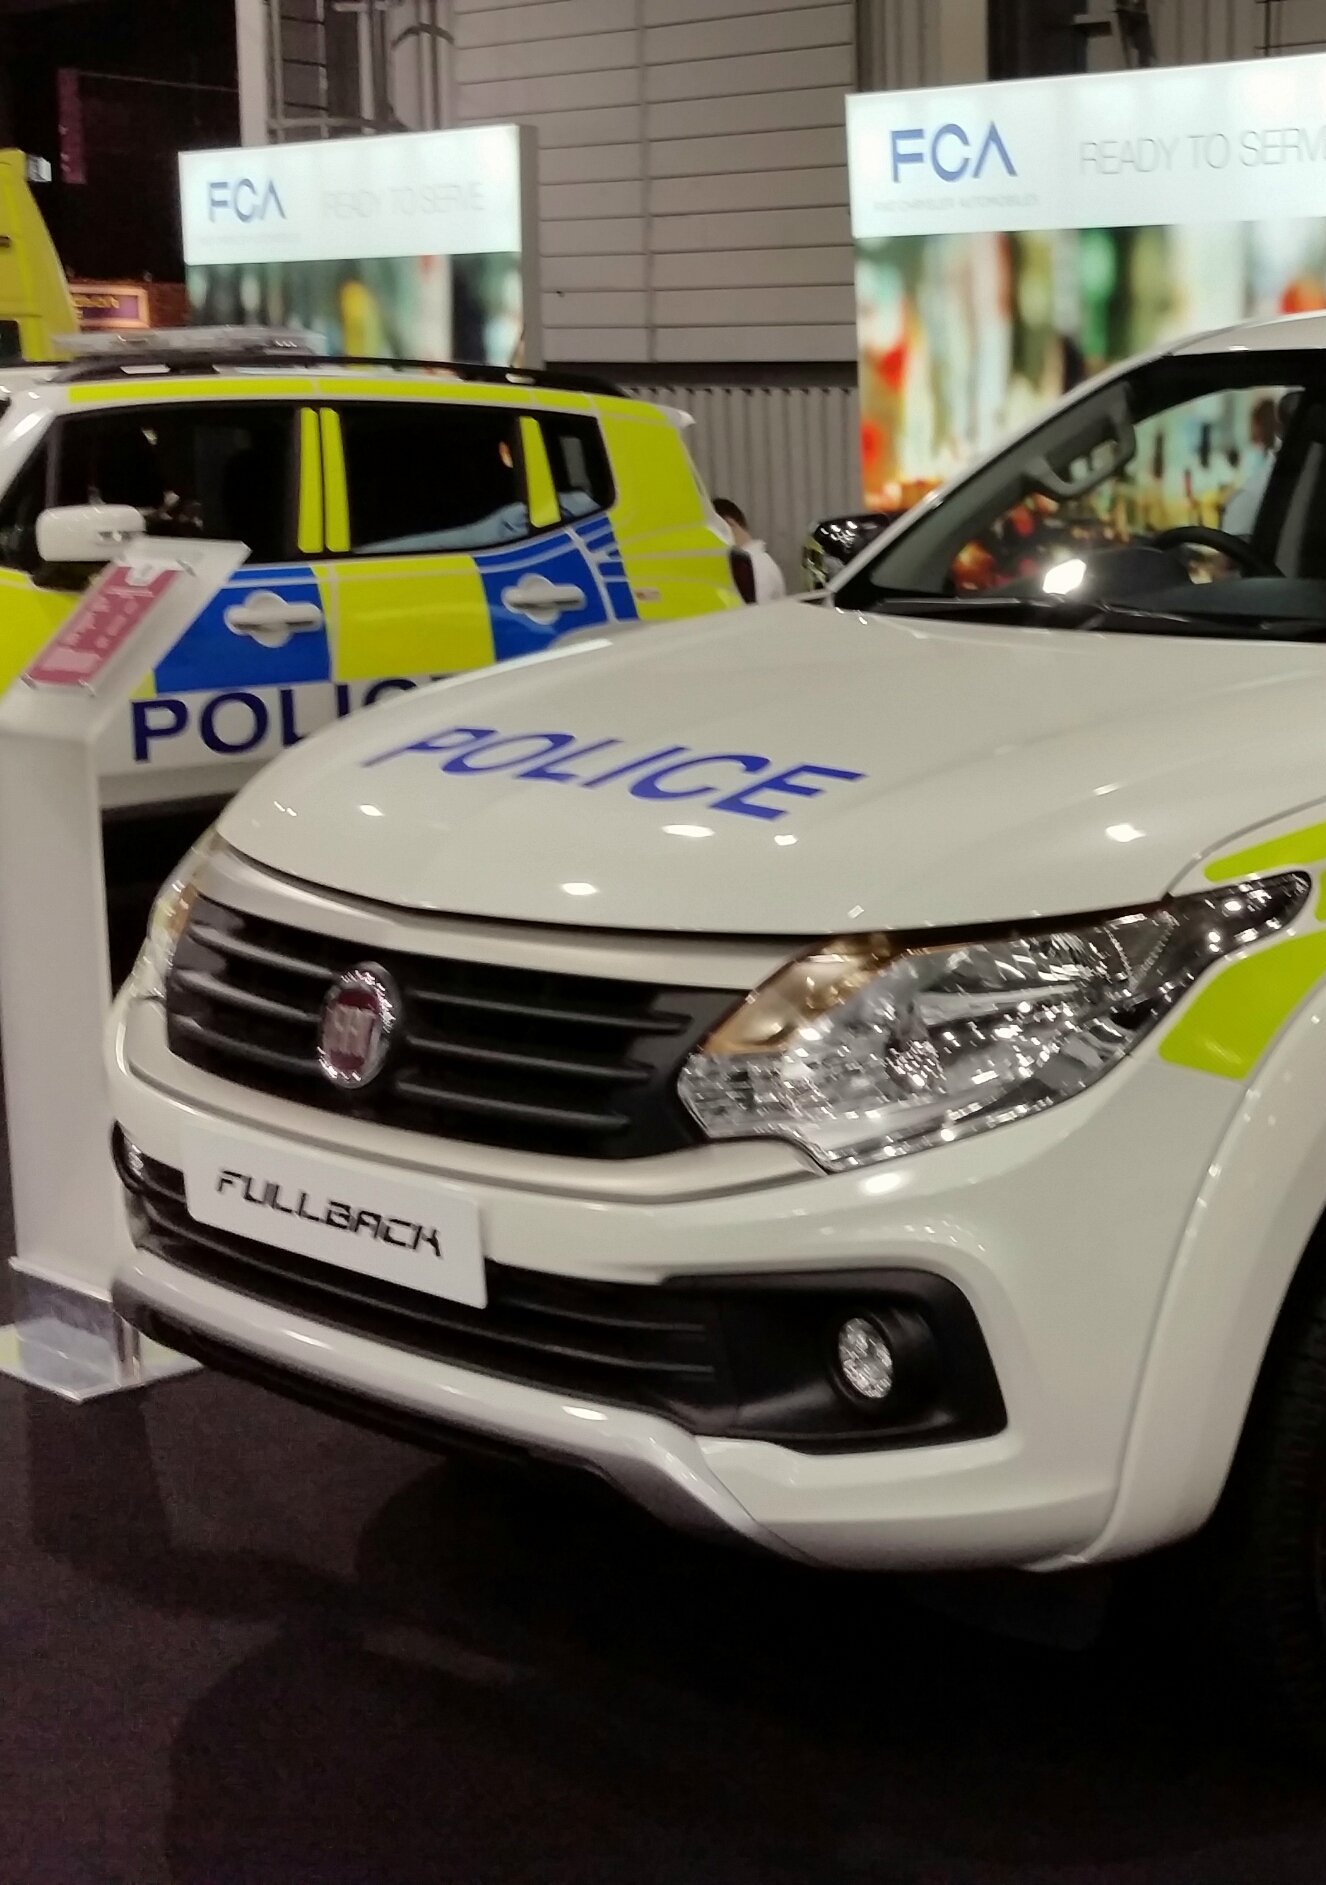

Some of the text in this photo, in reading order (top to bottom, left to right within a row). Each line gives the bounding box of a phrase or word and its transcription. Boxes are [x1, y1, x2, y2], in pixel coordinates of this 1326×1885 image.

[890, 120, 1018, 184] FCA
[1079, 136, 1177, 176] READY
[1188, 132, 1231, 170] TO
[207, 177, 287, 223] FCA
[131, 675, 450, 762] POLI
[362, 725, 866, 821] POLICE
[217, 1168, 443, 1258] FULLBACK
